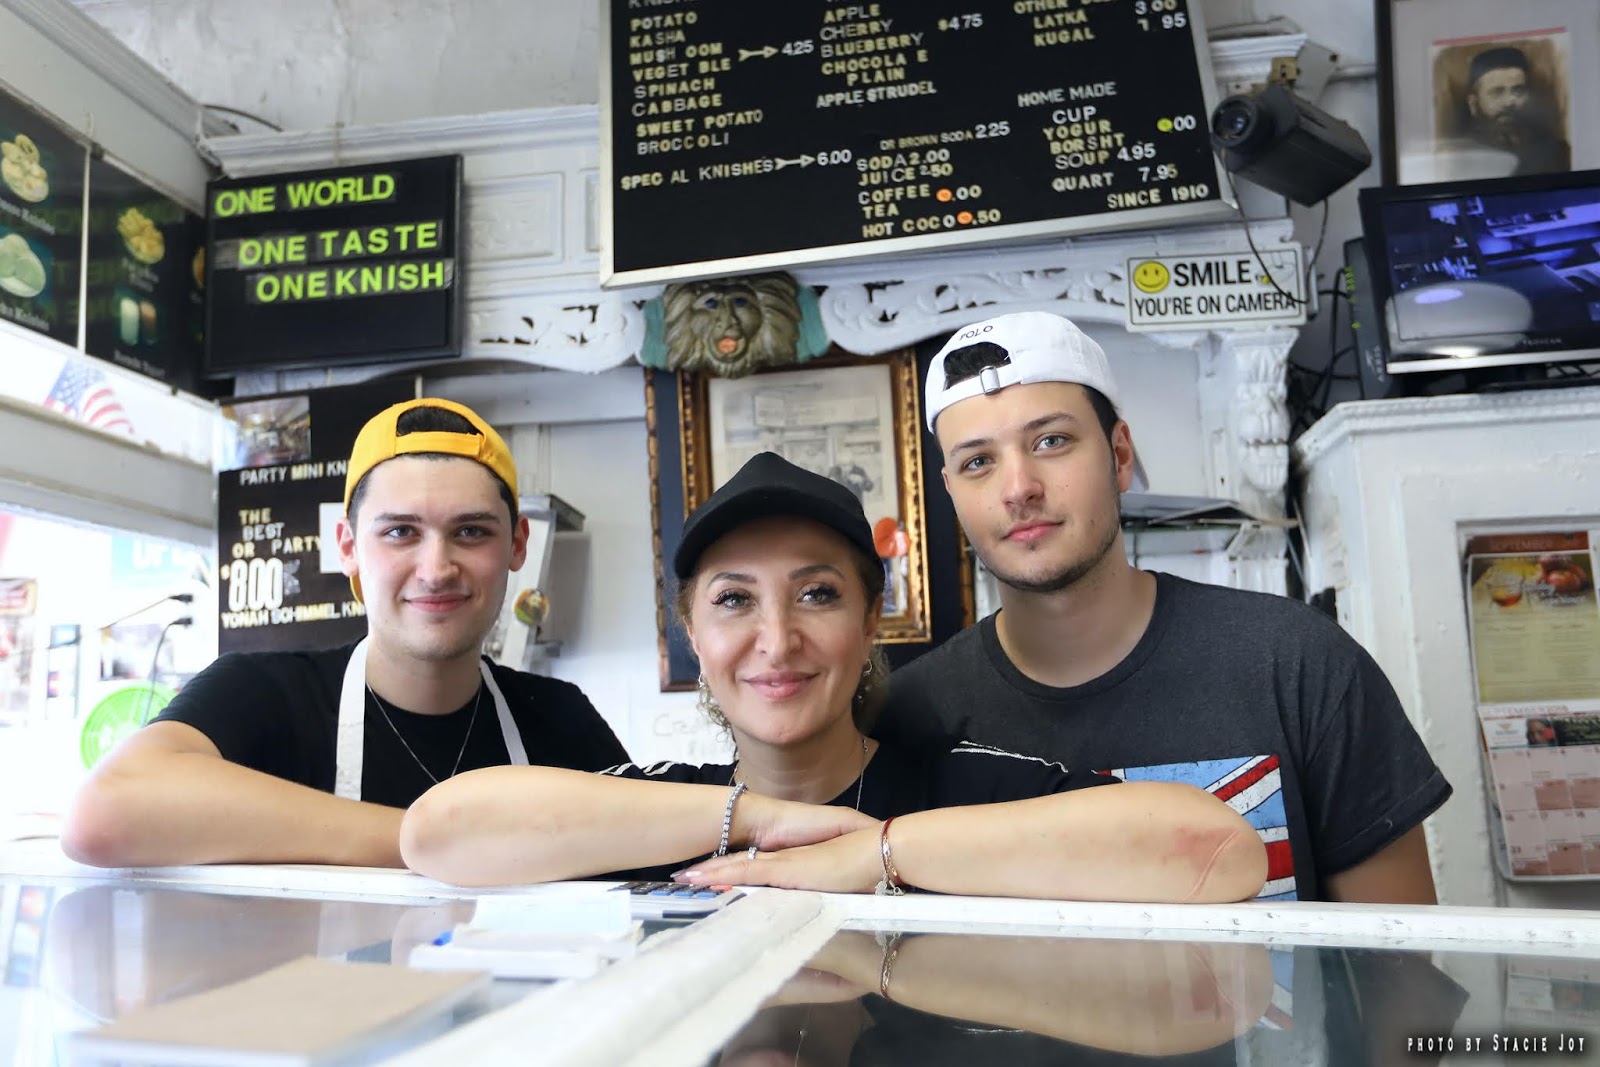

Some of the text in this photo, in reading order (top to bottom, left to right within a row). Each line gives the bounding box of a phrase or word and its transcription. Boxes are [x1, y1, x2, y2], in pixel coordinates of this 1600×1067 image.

[630, 12, 697, 30] POTATO
[824, 4, 881, 23] APPLE
[1033, 9, 1088, 29] LATKA
[629, 30, 685, 48] KASHA
[820, 19, 893, 41] CHERRY
[820, 32, 924, 58] BLUEBERRY
[847, 67, 905, 86] PLAIN
[634, 78, 715, 99] SPINACH
[816, 81, 937, 108] APPLE STRUDEL
[1017, 81, 1117, 108] HOME MADE
[632, 94, 722, 117] CABBAGE
[1052, 105, 1097, 125] CUP
[636, 109, 763, 138] SWEET POTATO
[637, 132, 729, 155] BROCCOLI
[699, 159, 773, 181] KNISHES
[856, 153, 908, 172] SODA
[1055, 150, 1110, 170] SOUP
[858, 166, 915, 186] JUICE
[1052, 172, 1114, 192] QUART
[215, 174, 395, 218] ONE WORLD
[858, 184, 930, 205] COFFEE
[1107, 183, 1209, 209] SINCE 1910
[862, 203, 899, 219] TEA
[862, 222, 894, 239] HOT
[238, 222, 438, 267] ONE TASTE
[255, 261, 444, 302] ONE KNISH
[1135, 291, 1296, 317] YOU'RE ON CAMERA
[959, 325, 994, 341] POLO
[240, 466, 287, 486] PARTY
[291, 462, 324, 480] MINI
[239, 507, 271, 525] THE
[243, 522, 285, 541] BEST
[221, 609, 269, 629] YONAH
